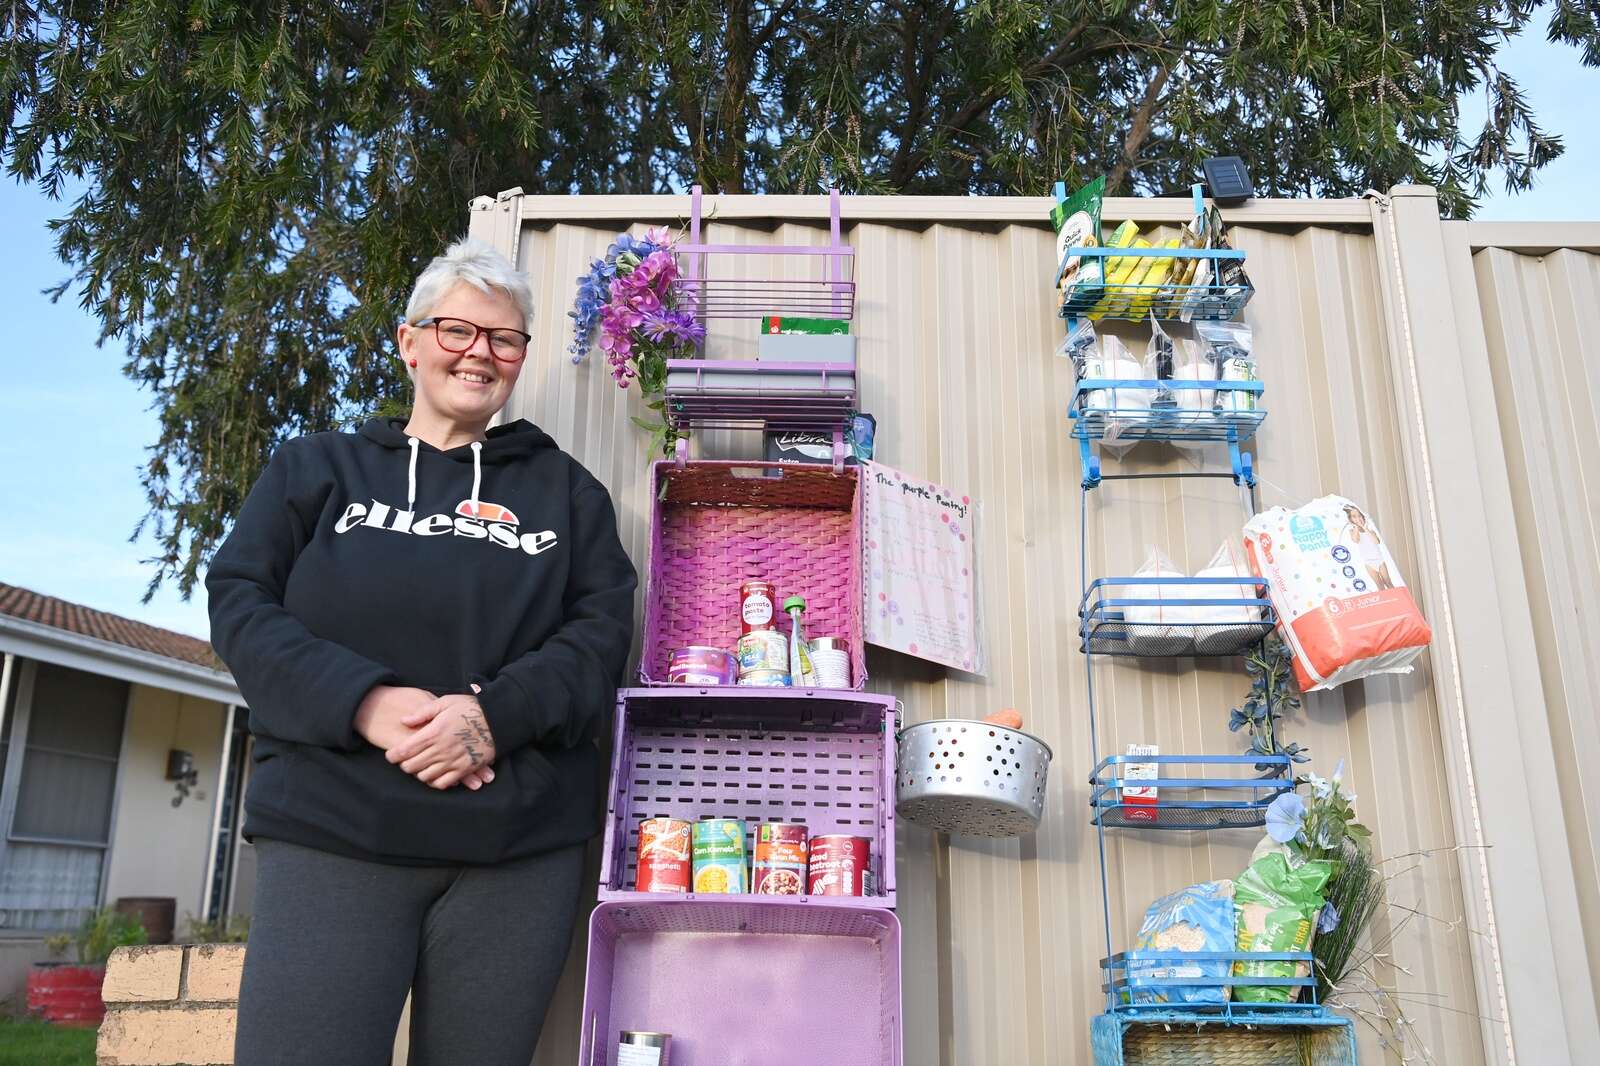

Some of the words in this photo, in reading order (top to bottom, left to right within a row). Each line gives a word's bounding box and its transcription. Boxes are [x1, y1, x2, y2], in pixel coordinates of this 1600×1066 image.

[779, 431, 833, 444] Libra
[875, 472, 894, 486] The
[936, 494, 967, 518] Pantry!
[335, 499, 558, 555] ellesse
[1293, 530, 1329, 544] Nappy
[1299, 540, 1331, 552] Pants
[744, 608, 765, 616] paste
[1328, 600, 1339, 613] 6
